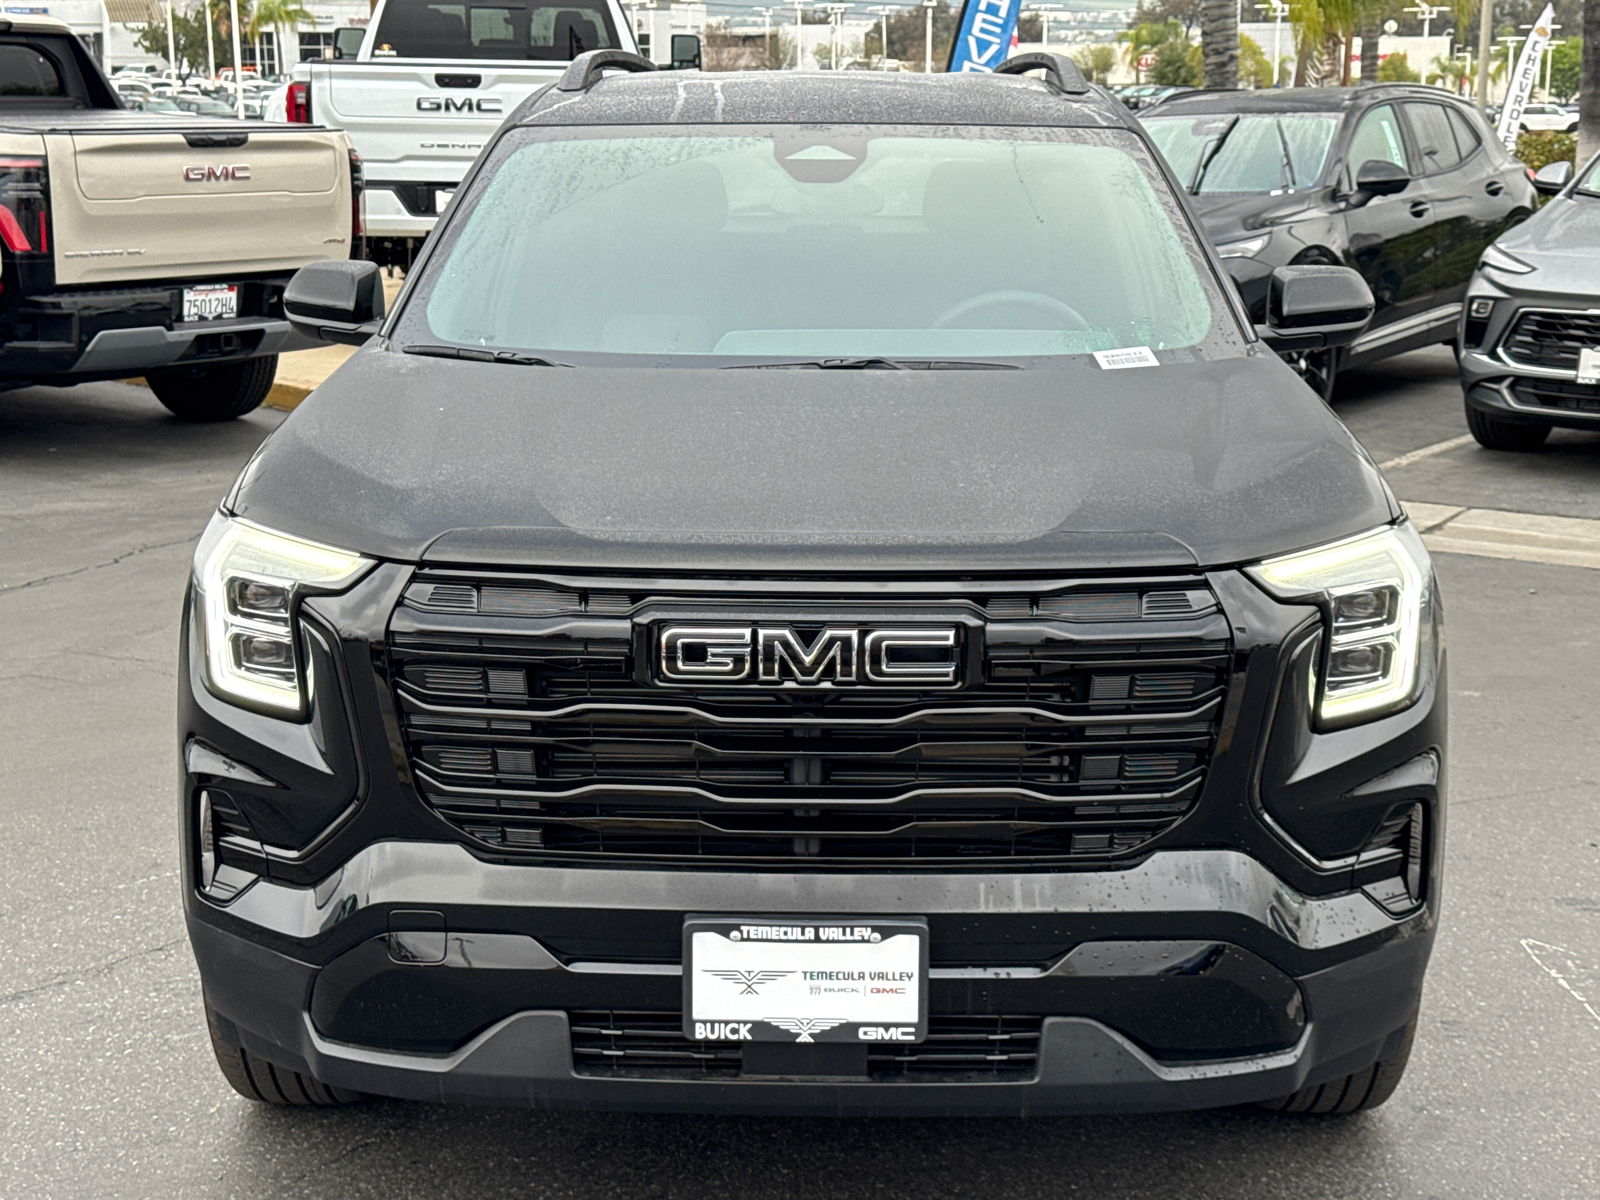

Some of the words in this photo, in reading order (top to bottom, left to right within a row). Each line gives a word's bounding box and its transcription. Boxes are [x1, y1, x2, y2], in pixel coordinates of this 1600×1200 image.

[416, 96, 503, 113] GMC
[184, 165, 251, 181] GMC
[661, 627, 957, 683] GMC
[740, 925, 815, 940] TEMECULA
[819, 927, 872, 940] VALLEY
[801, 971, 865, 981] TEMECULA
[869, 971, 914, 982] VALLEY
[870, 987, 906, 995] GMC
[695, 1023, 753, 1040] BUICK
[858, 1027, 916, 1041] GMC
